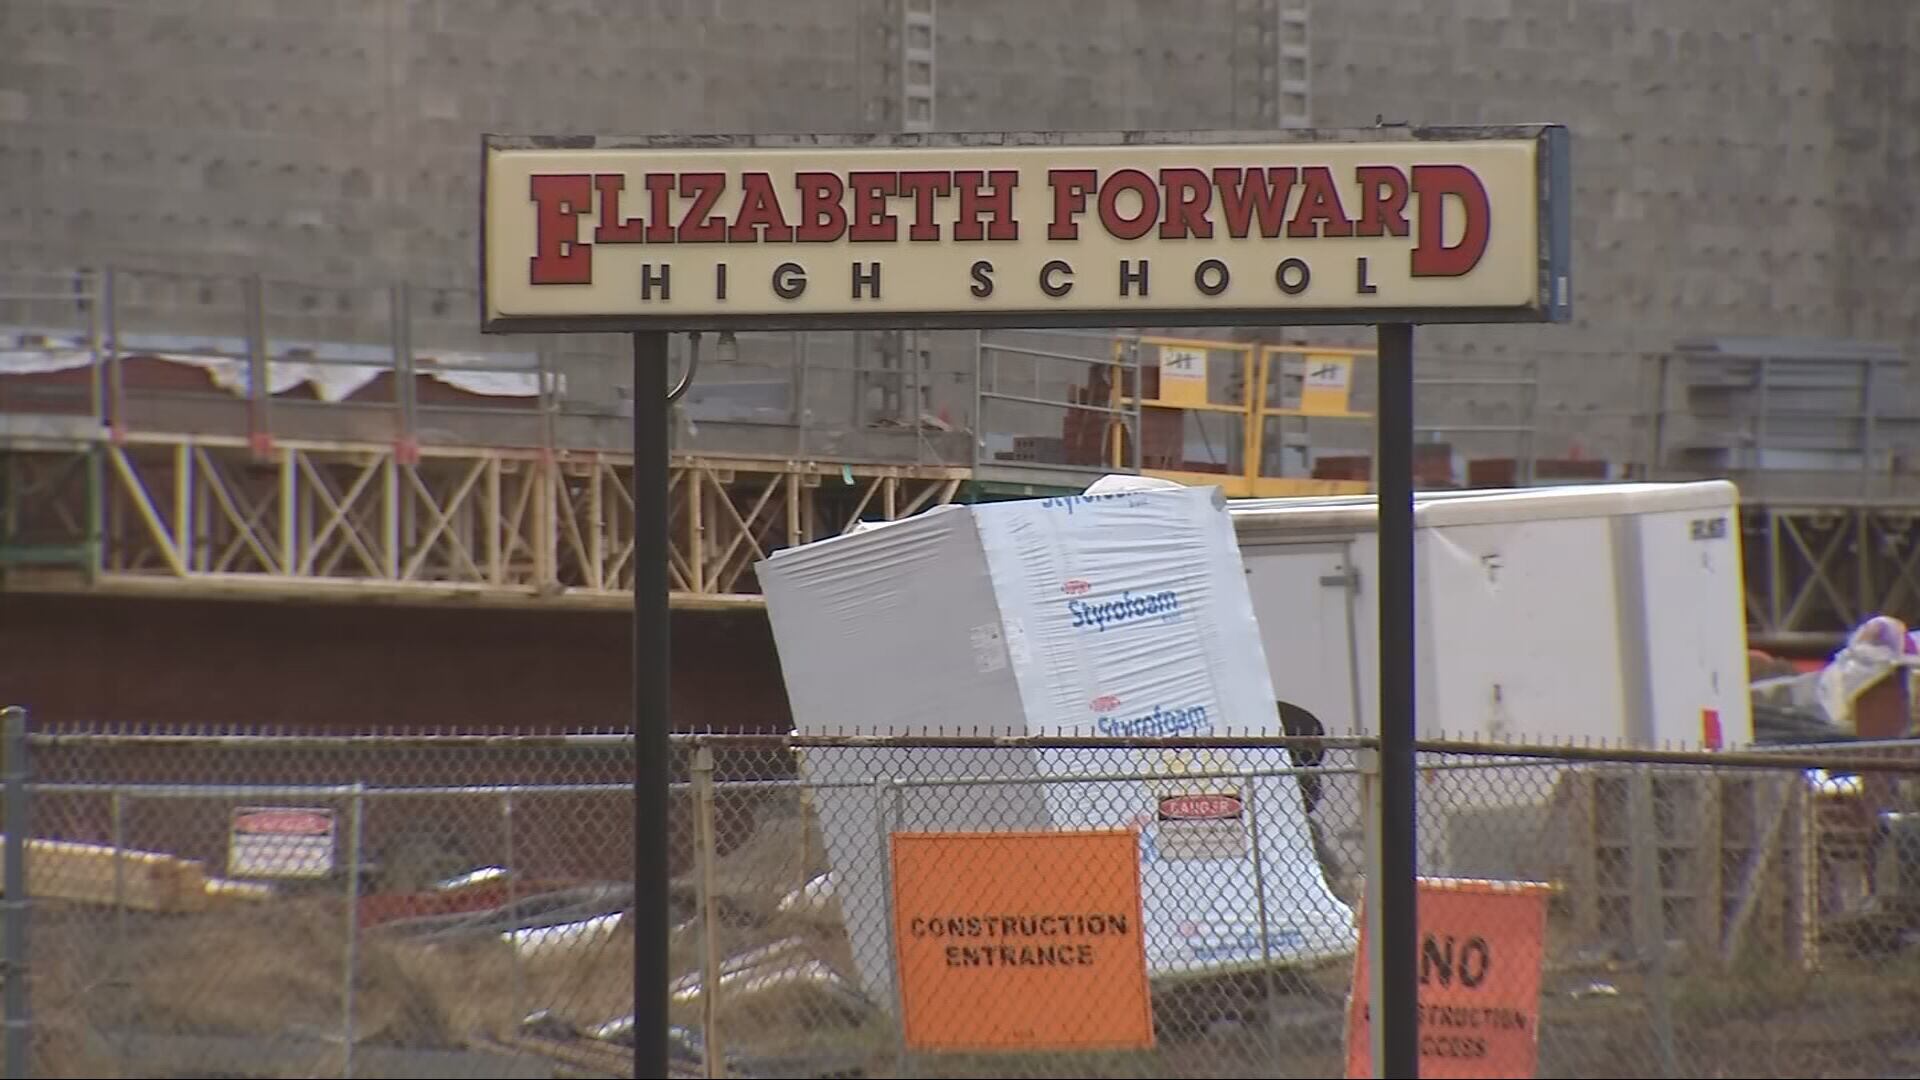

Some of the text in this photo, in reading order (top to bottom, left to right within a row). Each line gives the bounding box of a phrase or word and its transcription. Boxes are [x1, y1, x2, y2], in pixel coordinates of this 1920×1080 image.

[530, 164, 1491, 285] ELIZABETH FORWARD
[641, 256, 1378, 300] HIGH SCHOOL
[1068, 591, 1179, 632] Styrofoam
[911, 913, 1127, 939] CONSTRUCTION
[945, 944, 1094, 968] ENTRANCE
[1419, 935, 1489, 988] NO
[1420, 1036, 1487, 1058] CCESS
